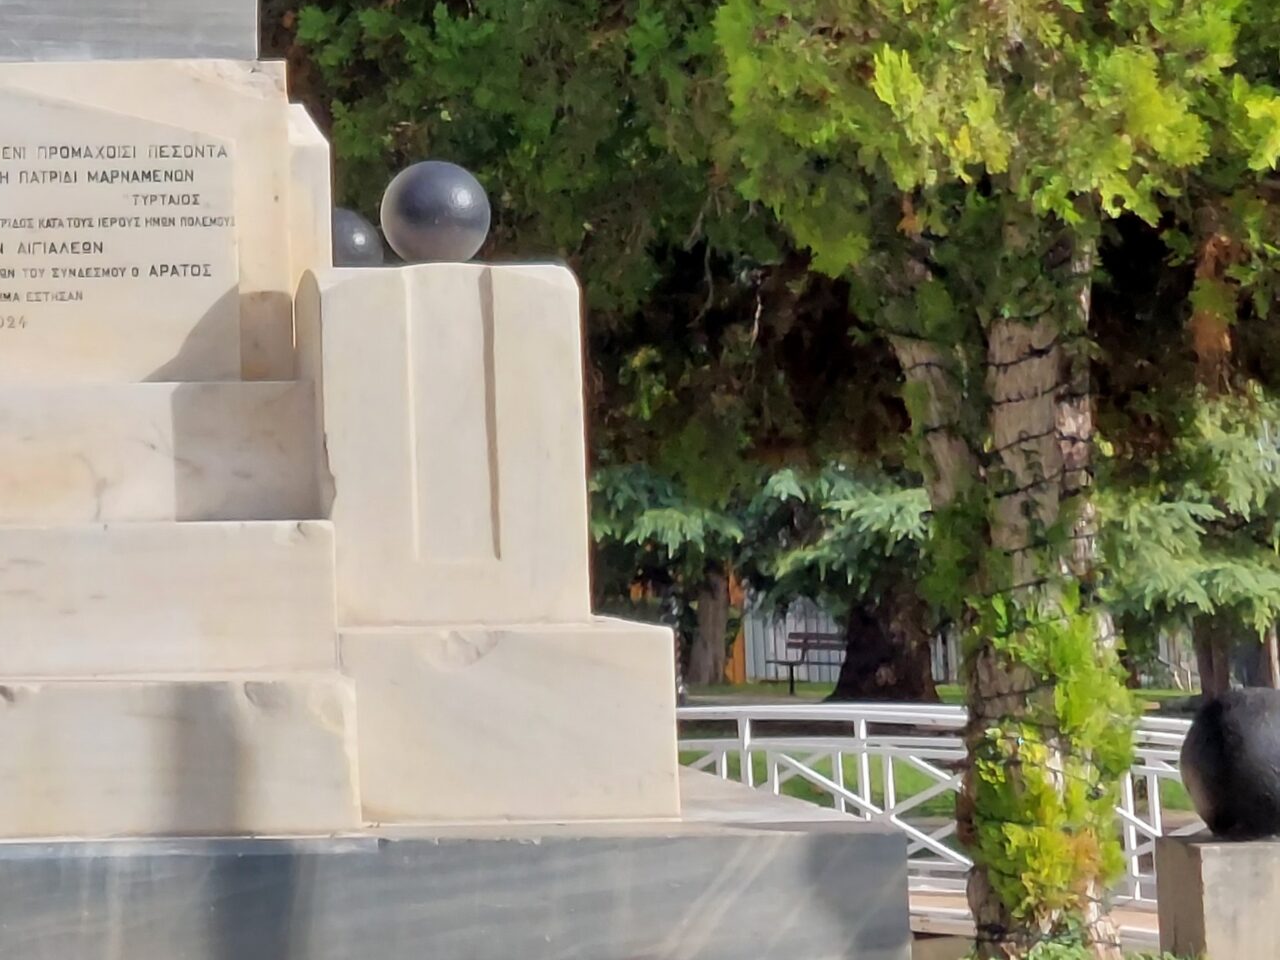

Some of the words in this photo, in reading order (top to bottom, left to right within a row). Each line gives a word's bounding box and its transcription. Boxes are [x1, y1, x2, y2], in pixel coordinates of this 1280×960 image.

[2, 147, 26, 160] ΕΝΙ
[37, 146, 135, 159] ΠΡΟΜΑΧΟΙΣΙ
[148, 145, 227, 159] ΠΕΣΟΝΤΑ
[0, 171, 9, 184] Η
[19, 170, 77, 184] ΠΑΤΡΙΔΙ
[88, 170, 194, 183] ΜΑΡΝΑΜΕΝΩΝ
[132, 194, 200, 206] ΤΥΡΤΑΙΟΣ
[39, 218, 64, 229] ΚΑΤΑ
[67, 218, 94, 228] ΤΟΥΣ
[98, 217, 140, 228] ΙΕΡΟΥΣ
[145, 217, 175, 227] ΗΜΩΝ
[181, 217, 235, 227] ΠΟΛΕΜΟΥΣ
[17, 242, 103, 255] ΑΙΓΙΑΛΕΩΝ
[22, 268, 45, 278] ΤΟΥ
[52, 267, 127, 278] ΣΥΝΔΕΣΜΟΥ
[149, 264, 212, 277] ΑΡΑΤΟΣ
[26, 291, 83, 302] ΕΣΤΗΣΑΝ
